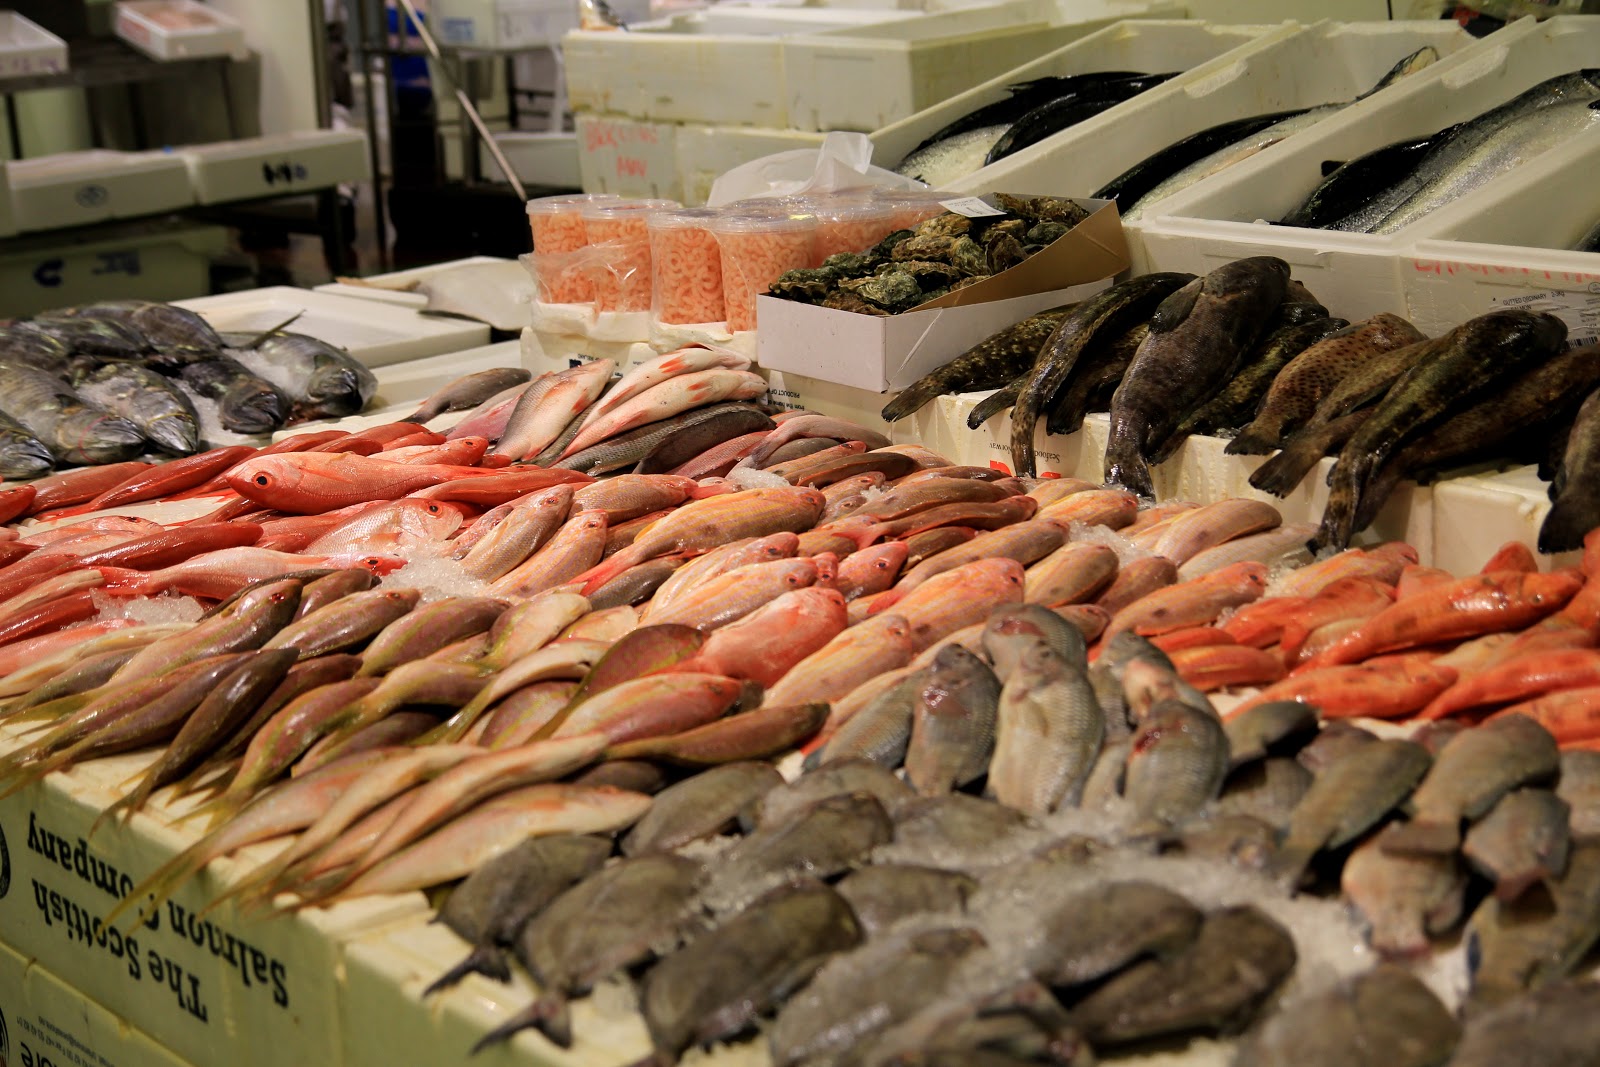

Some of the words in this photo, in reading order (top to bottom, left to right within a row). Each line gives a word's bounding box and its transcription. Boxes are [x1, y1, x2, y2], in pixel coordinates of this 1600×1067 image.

[1503, 298, 1522, 306] GUTTED
[1522, 293, 1547, 304] ORDINARY
[778, 390, 800, 399] PRODUCT
[793, 404, 805, 412] from
[31, 878, 142, 981] Scottish
[167, 899, 289, 1009] Salmon
[148, 949, 208, 1024] The
